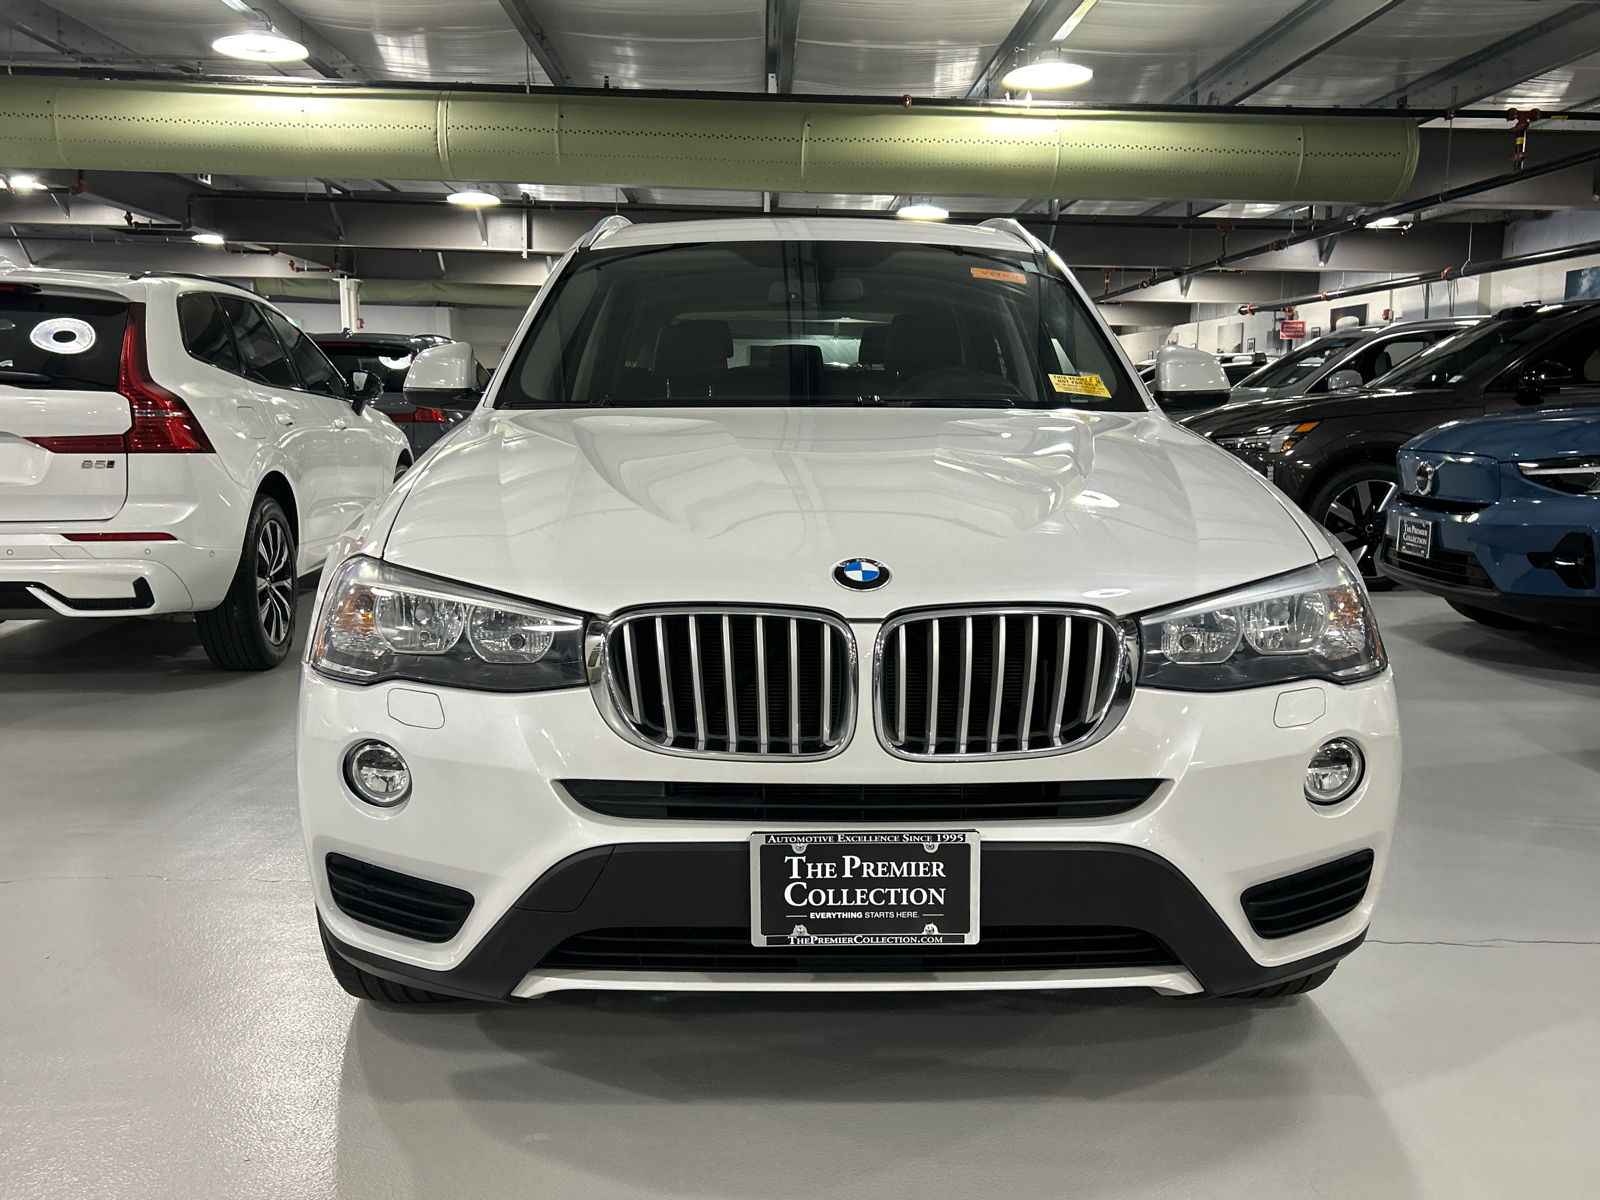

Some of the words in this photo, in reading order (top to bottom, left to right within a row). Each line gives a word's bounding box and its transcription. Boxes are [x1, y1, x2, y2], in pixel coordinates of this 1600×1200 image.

[768, 835, 834, 843] AUTOMOTIVE
[838, 834, 900, 843] EXCELLENCE
[902, 833, 933, 842] SINCE
[936, 834, 964, 842] 1995
[784, 855, 838, 879] THE
[841, 855, 947, 878] PREMIER
[784, 881, 946, 907] COLLECTION
[864, 911, 895, 919] STARTS
[787, 935, 943, 945] THEPREMIERCOLLECTION.COM
